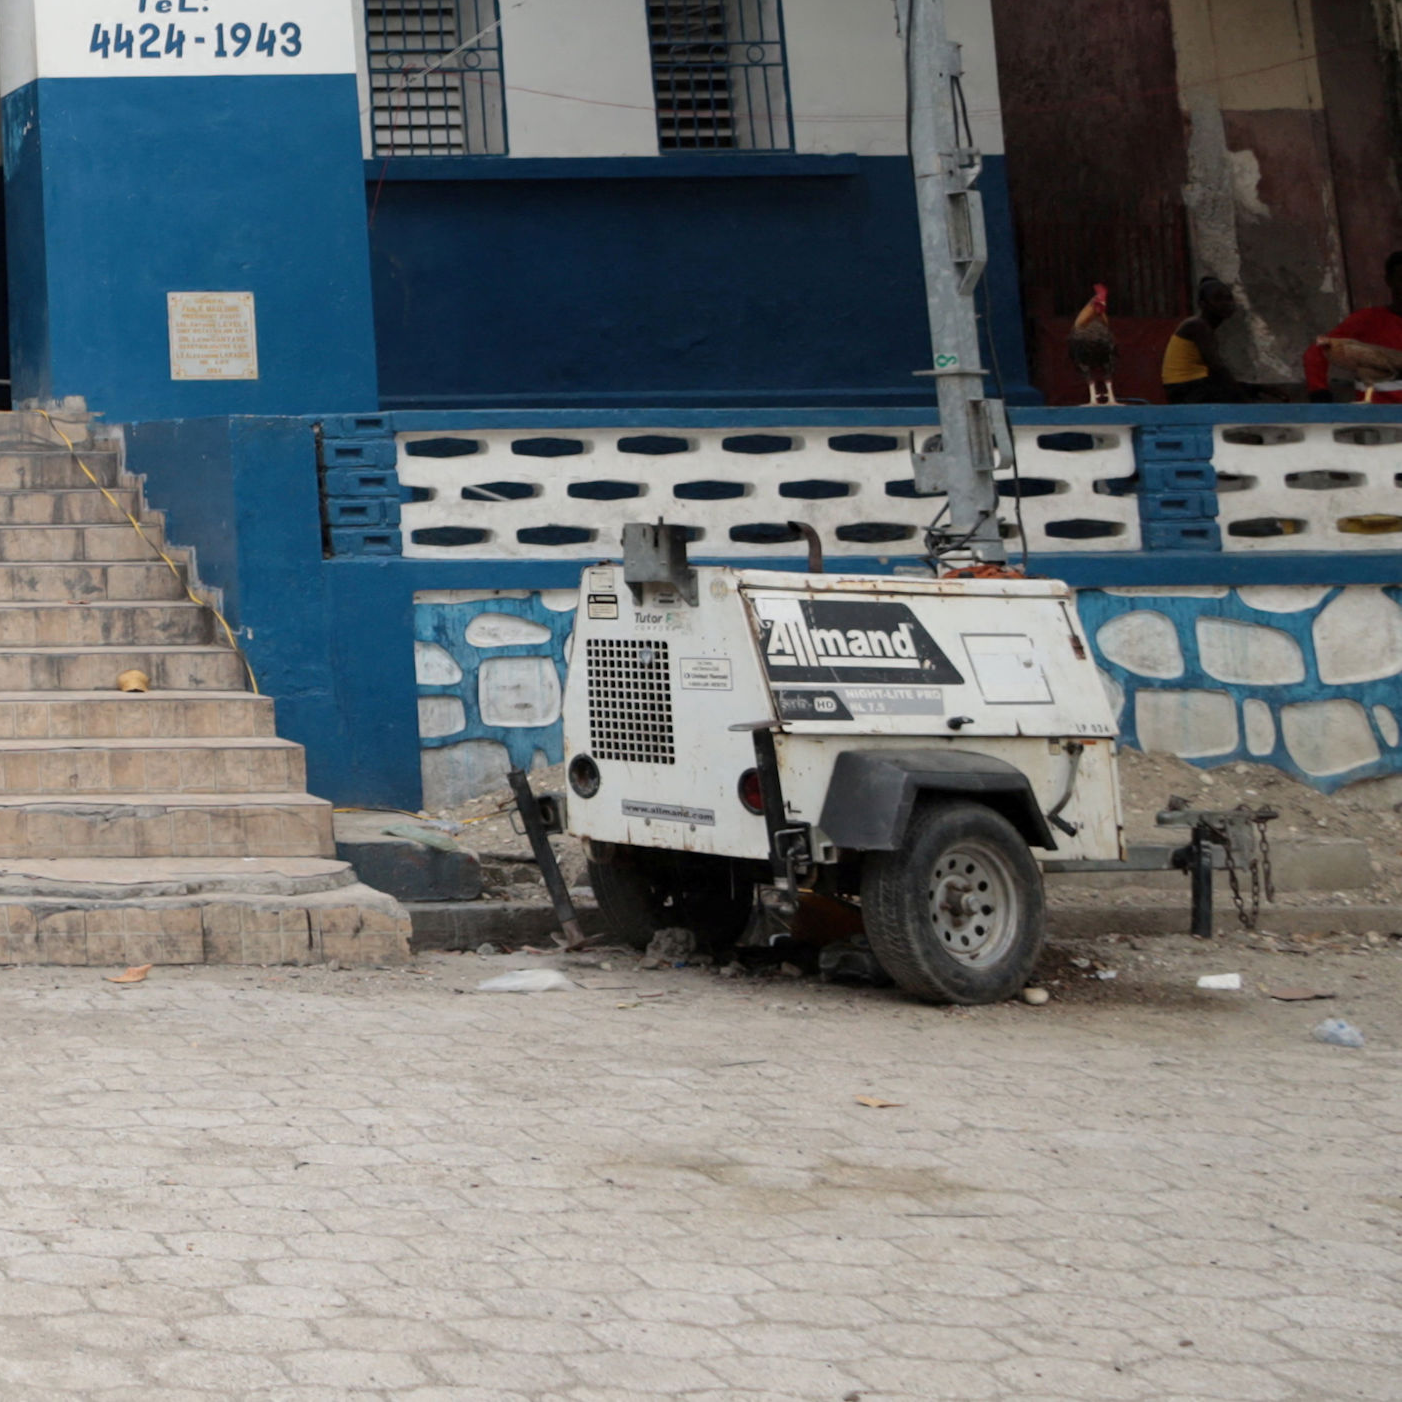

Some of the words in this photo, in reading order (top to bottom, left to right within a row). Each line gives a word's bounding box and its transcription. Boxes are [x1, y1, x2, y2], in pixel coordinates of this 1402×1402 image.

[89, 22, 302, 59] 4424-1943
[634, 611, 663, 624] Tutor
[766, 618, 918, 667] Allmand
[846, 688, 914, 700] NIGHT-LITE
[916, 689, 942, 700] PRO
[816, 699, 835, 710] HD
[625, 802, 714, 821] www.allmand.com
